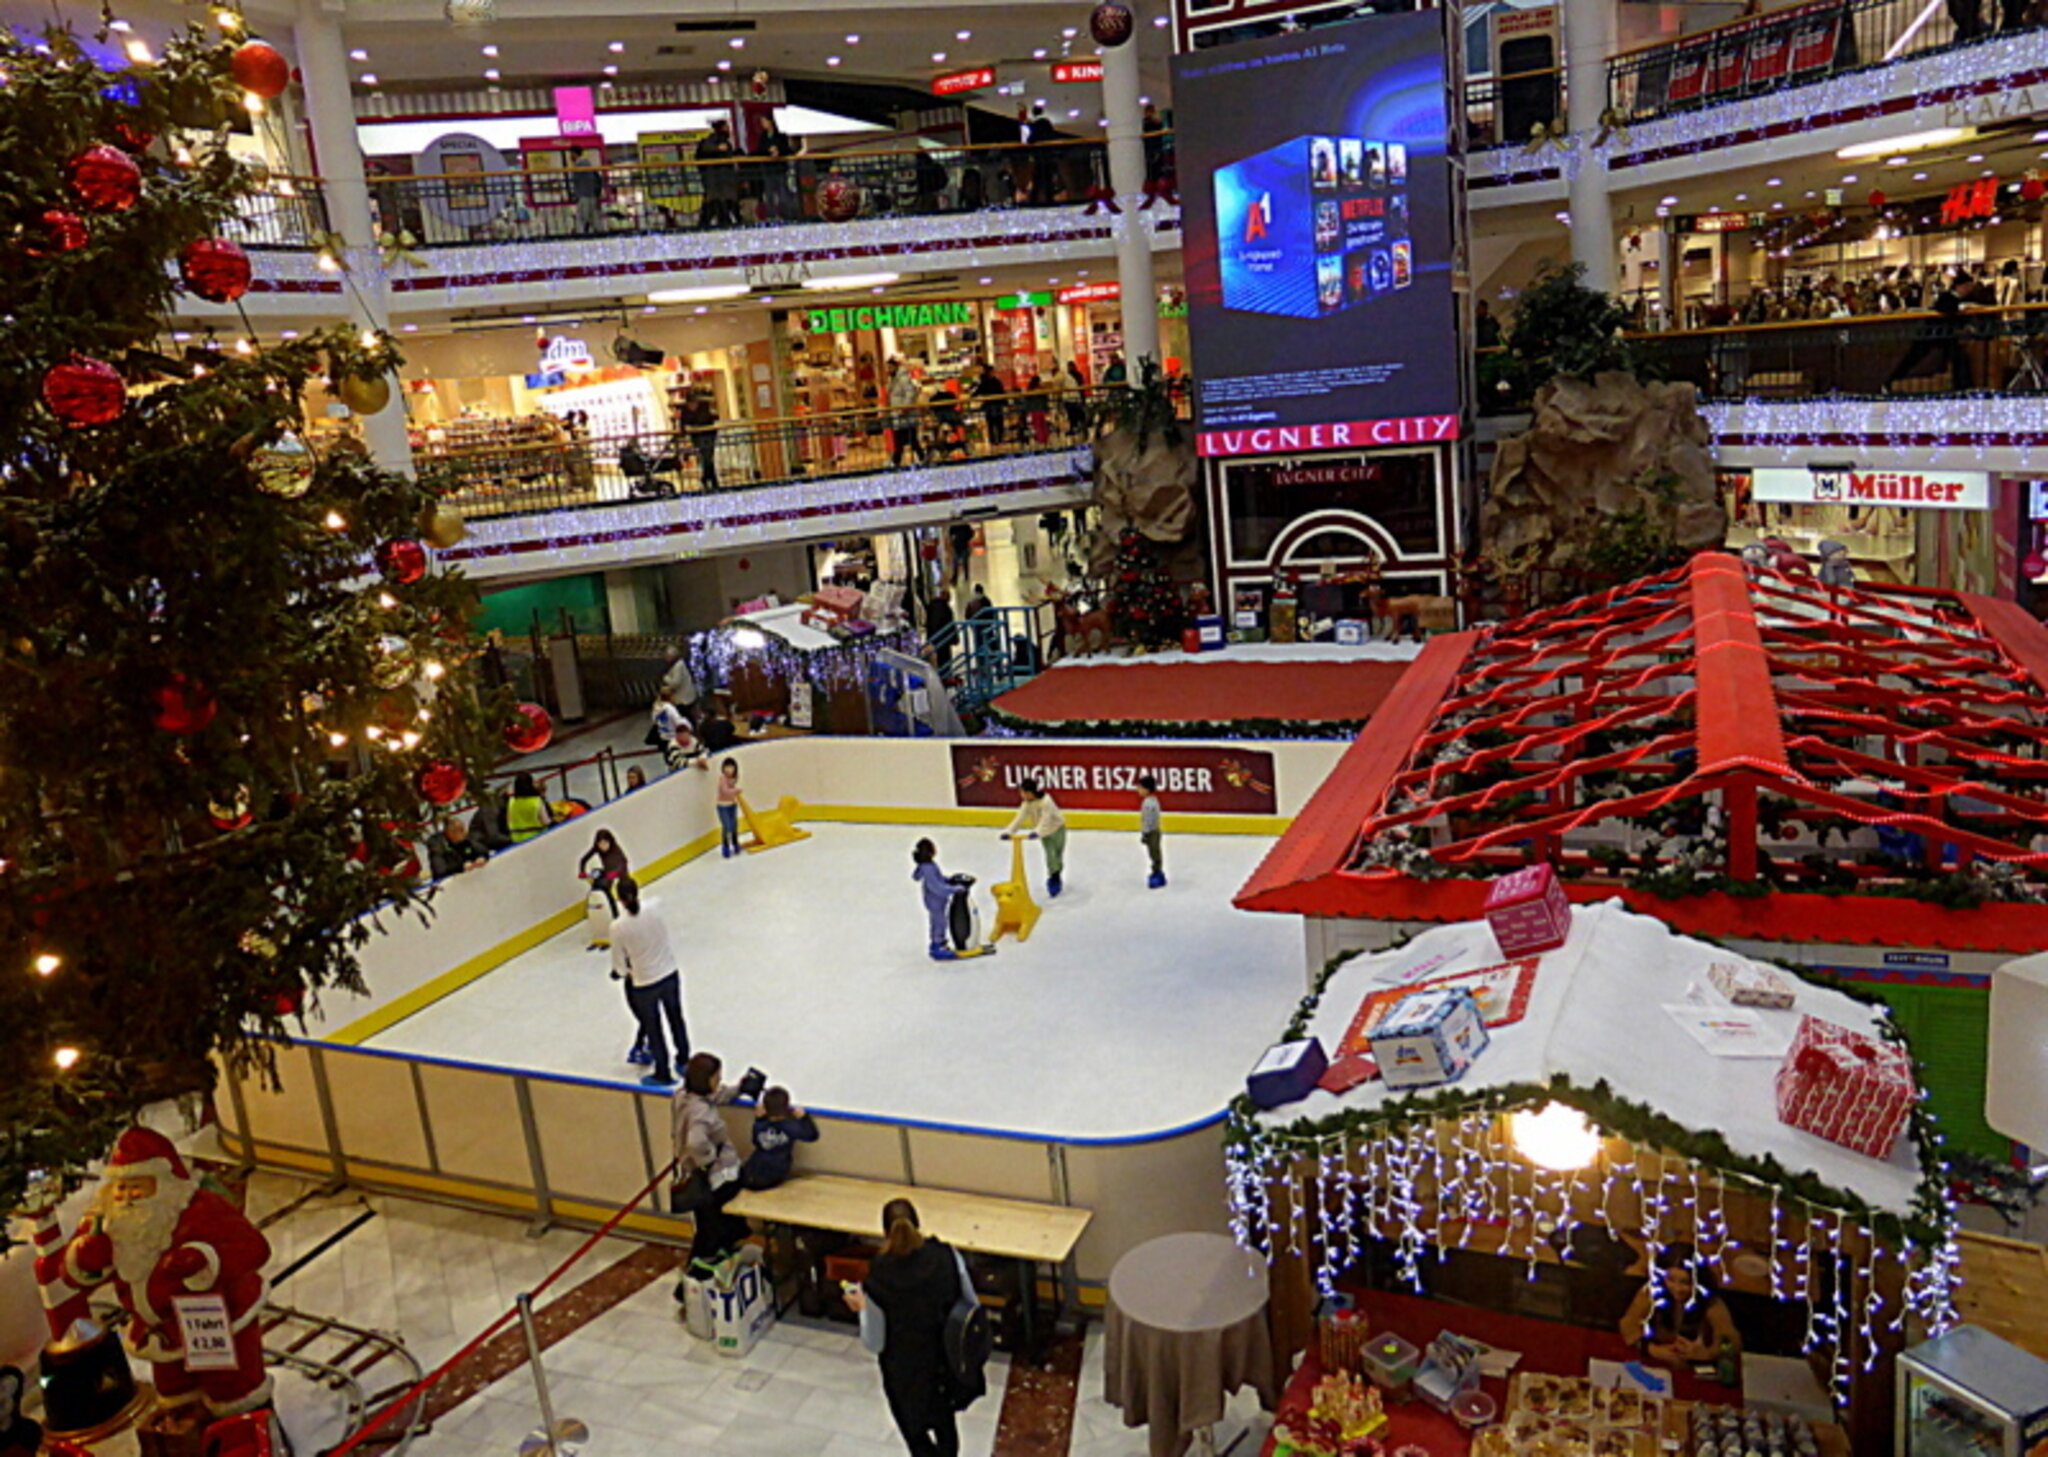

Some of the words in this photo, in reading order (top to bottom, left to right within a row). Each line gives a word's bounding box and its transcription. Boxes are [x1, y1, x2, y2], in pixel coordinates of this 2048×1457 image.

[1945, 89, 2033, 127] PLAZA
[562, 119, 592, 134] BIPA
[1940, 176, 1999, 225] H&M
[1245, 191, 1272, 243] A1
[809, 303, 970, 335] DEICHMANN
[549, 340, 586, 359] dm
[1205, 423, 1350, 455] LUGNER
[1371, 416, 1452, 443] CITY
[1848, 473, 1964, 502] Müller
[1004, 764, 1089, 790] LUGNER
[195, 1318, 225, 1331] Fahrt
